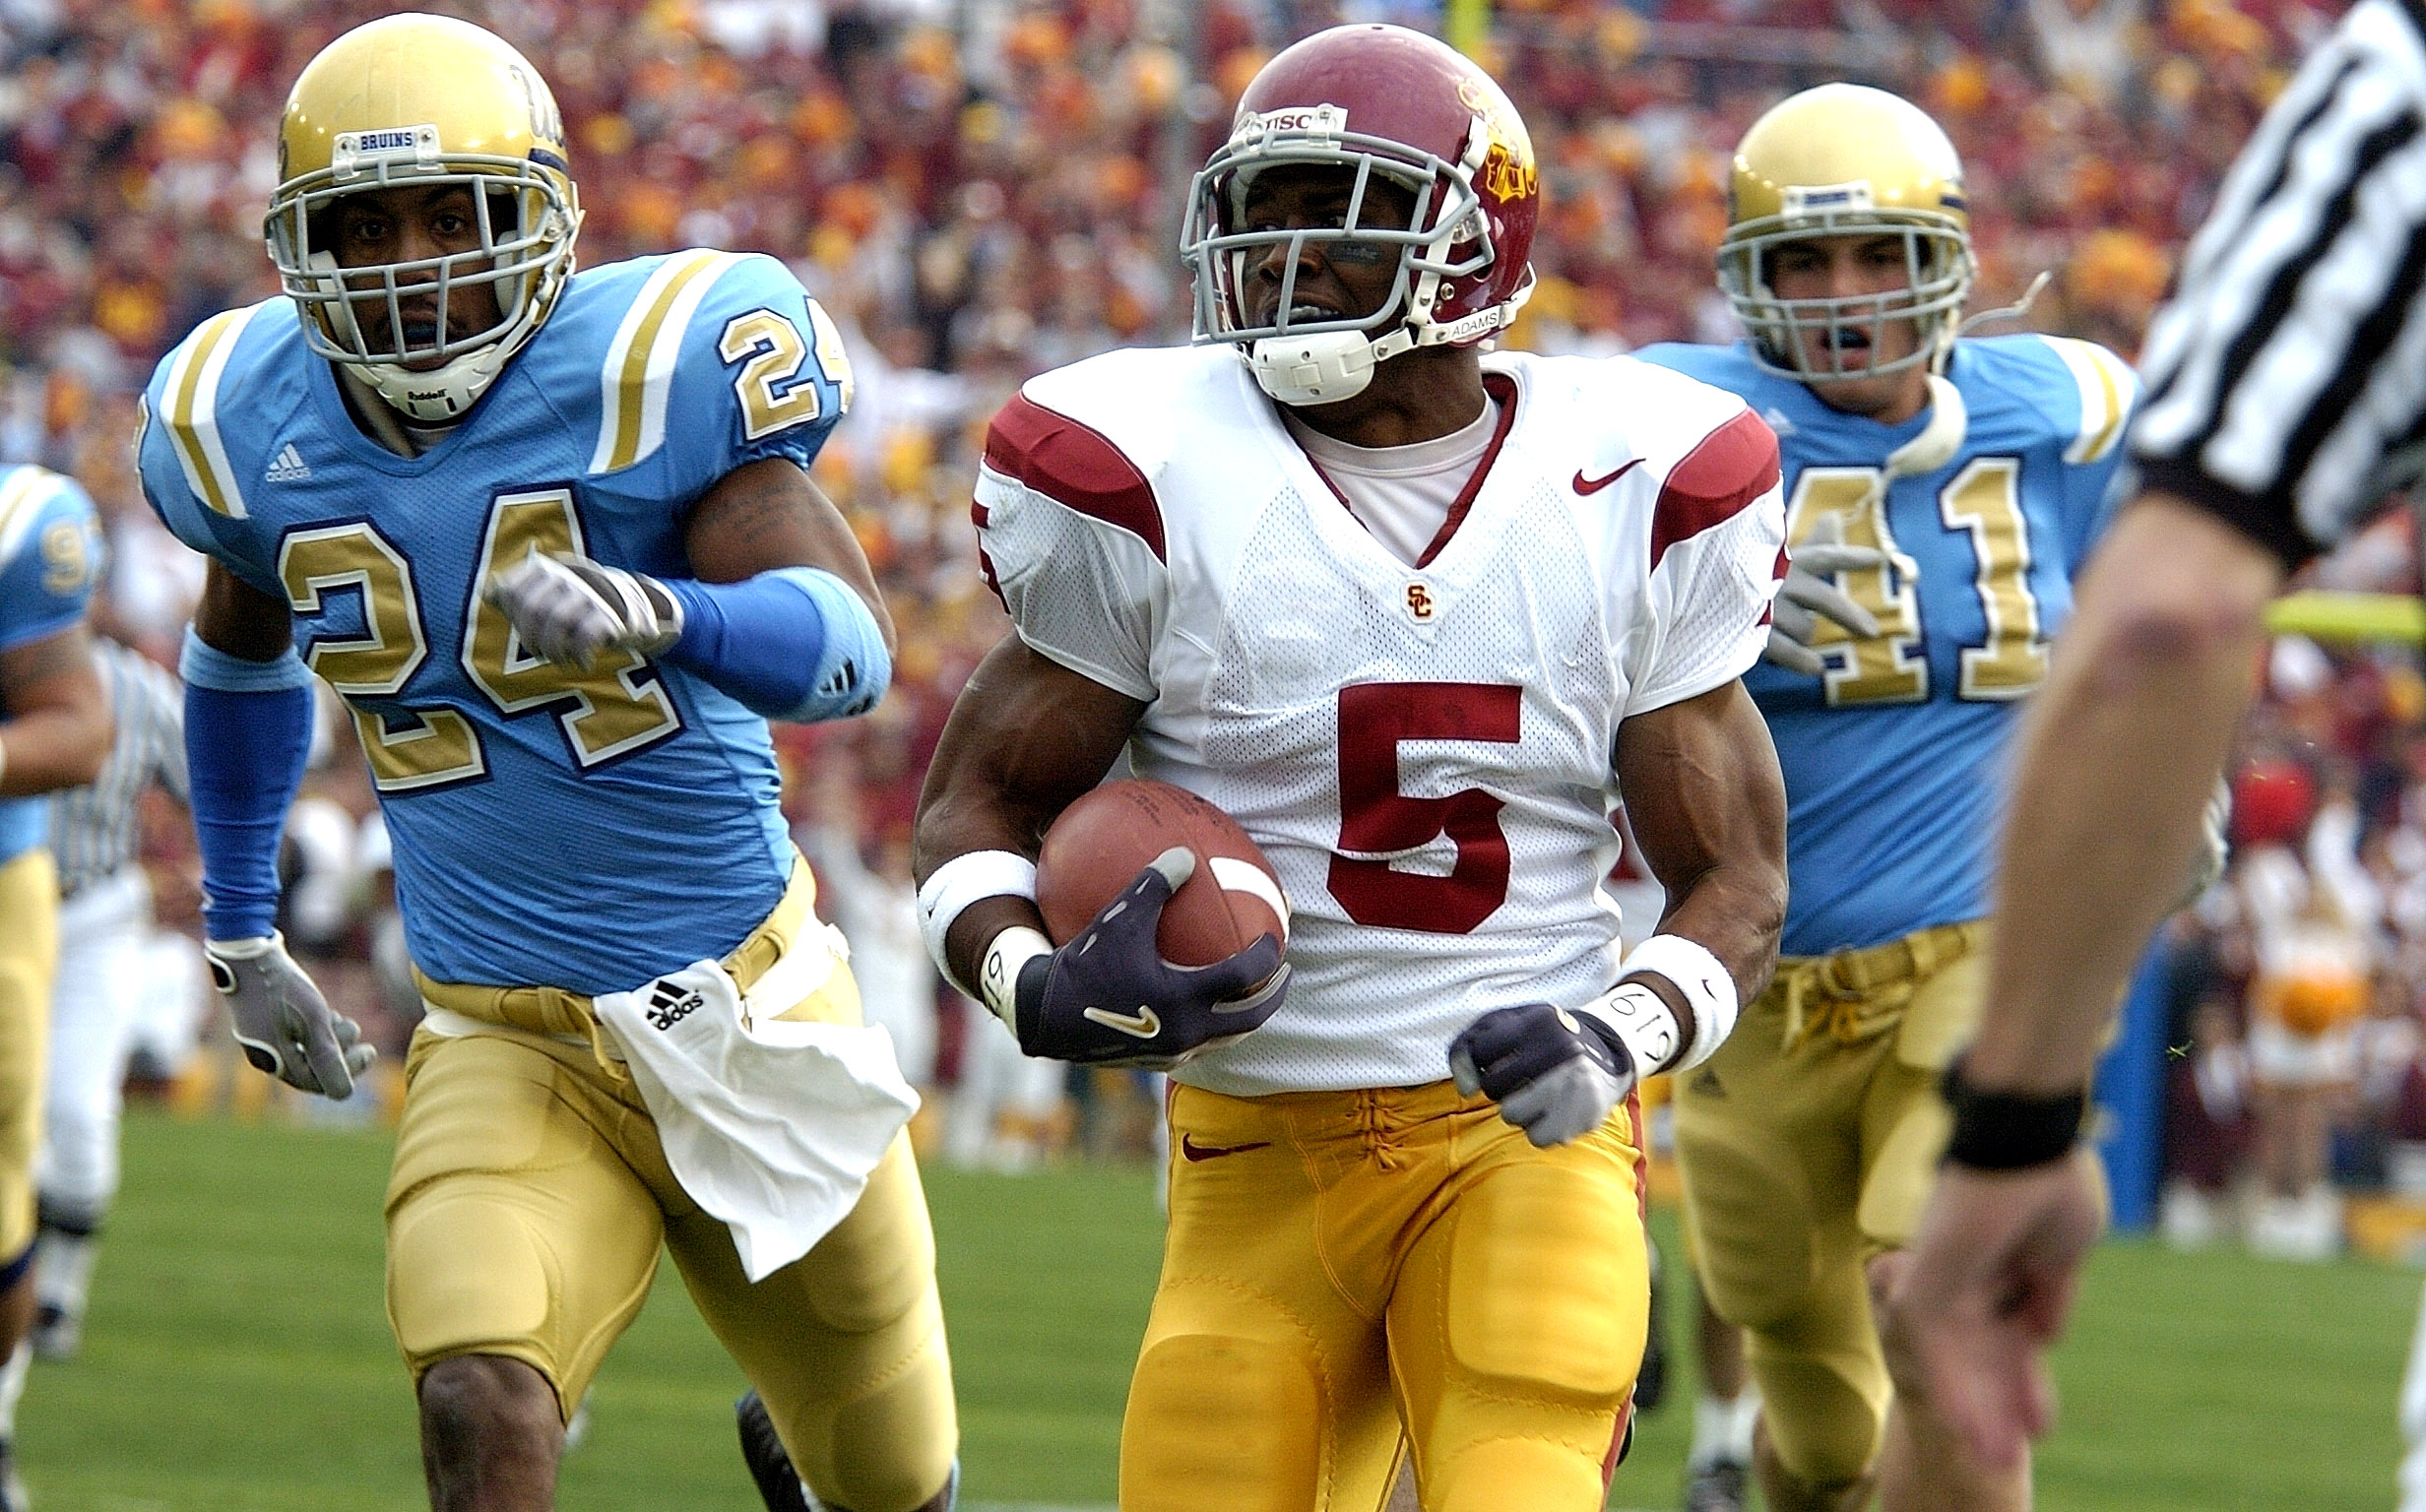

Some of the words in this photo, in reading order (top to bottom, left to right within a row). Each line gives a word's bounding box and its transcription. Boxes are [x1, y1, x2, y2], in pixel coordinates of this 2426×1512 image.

[1266, 114, 1312, 130] USC
[360, 132, 413, 151] BRUINS
[1452, 312, 1498, 337] ADAMS
[266, 468, 311, 481] adidas
[1784, 456, 2051, 707] 41
[1408, 585, 1432, 617] SC
[279, 487, 680, 791] 24
[1326, 681, 1522, 935] 5
[653, 994, 703, 1031] didas
